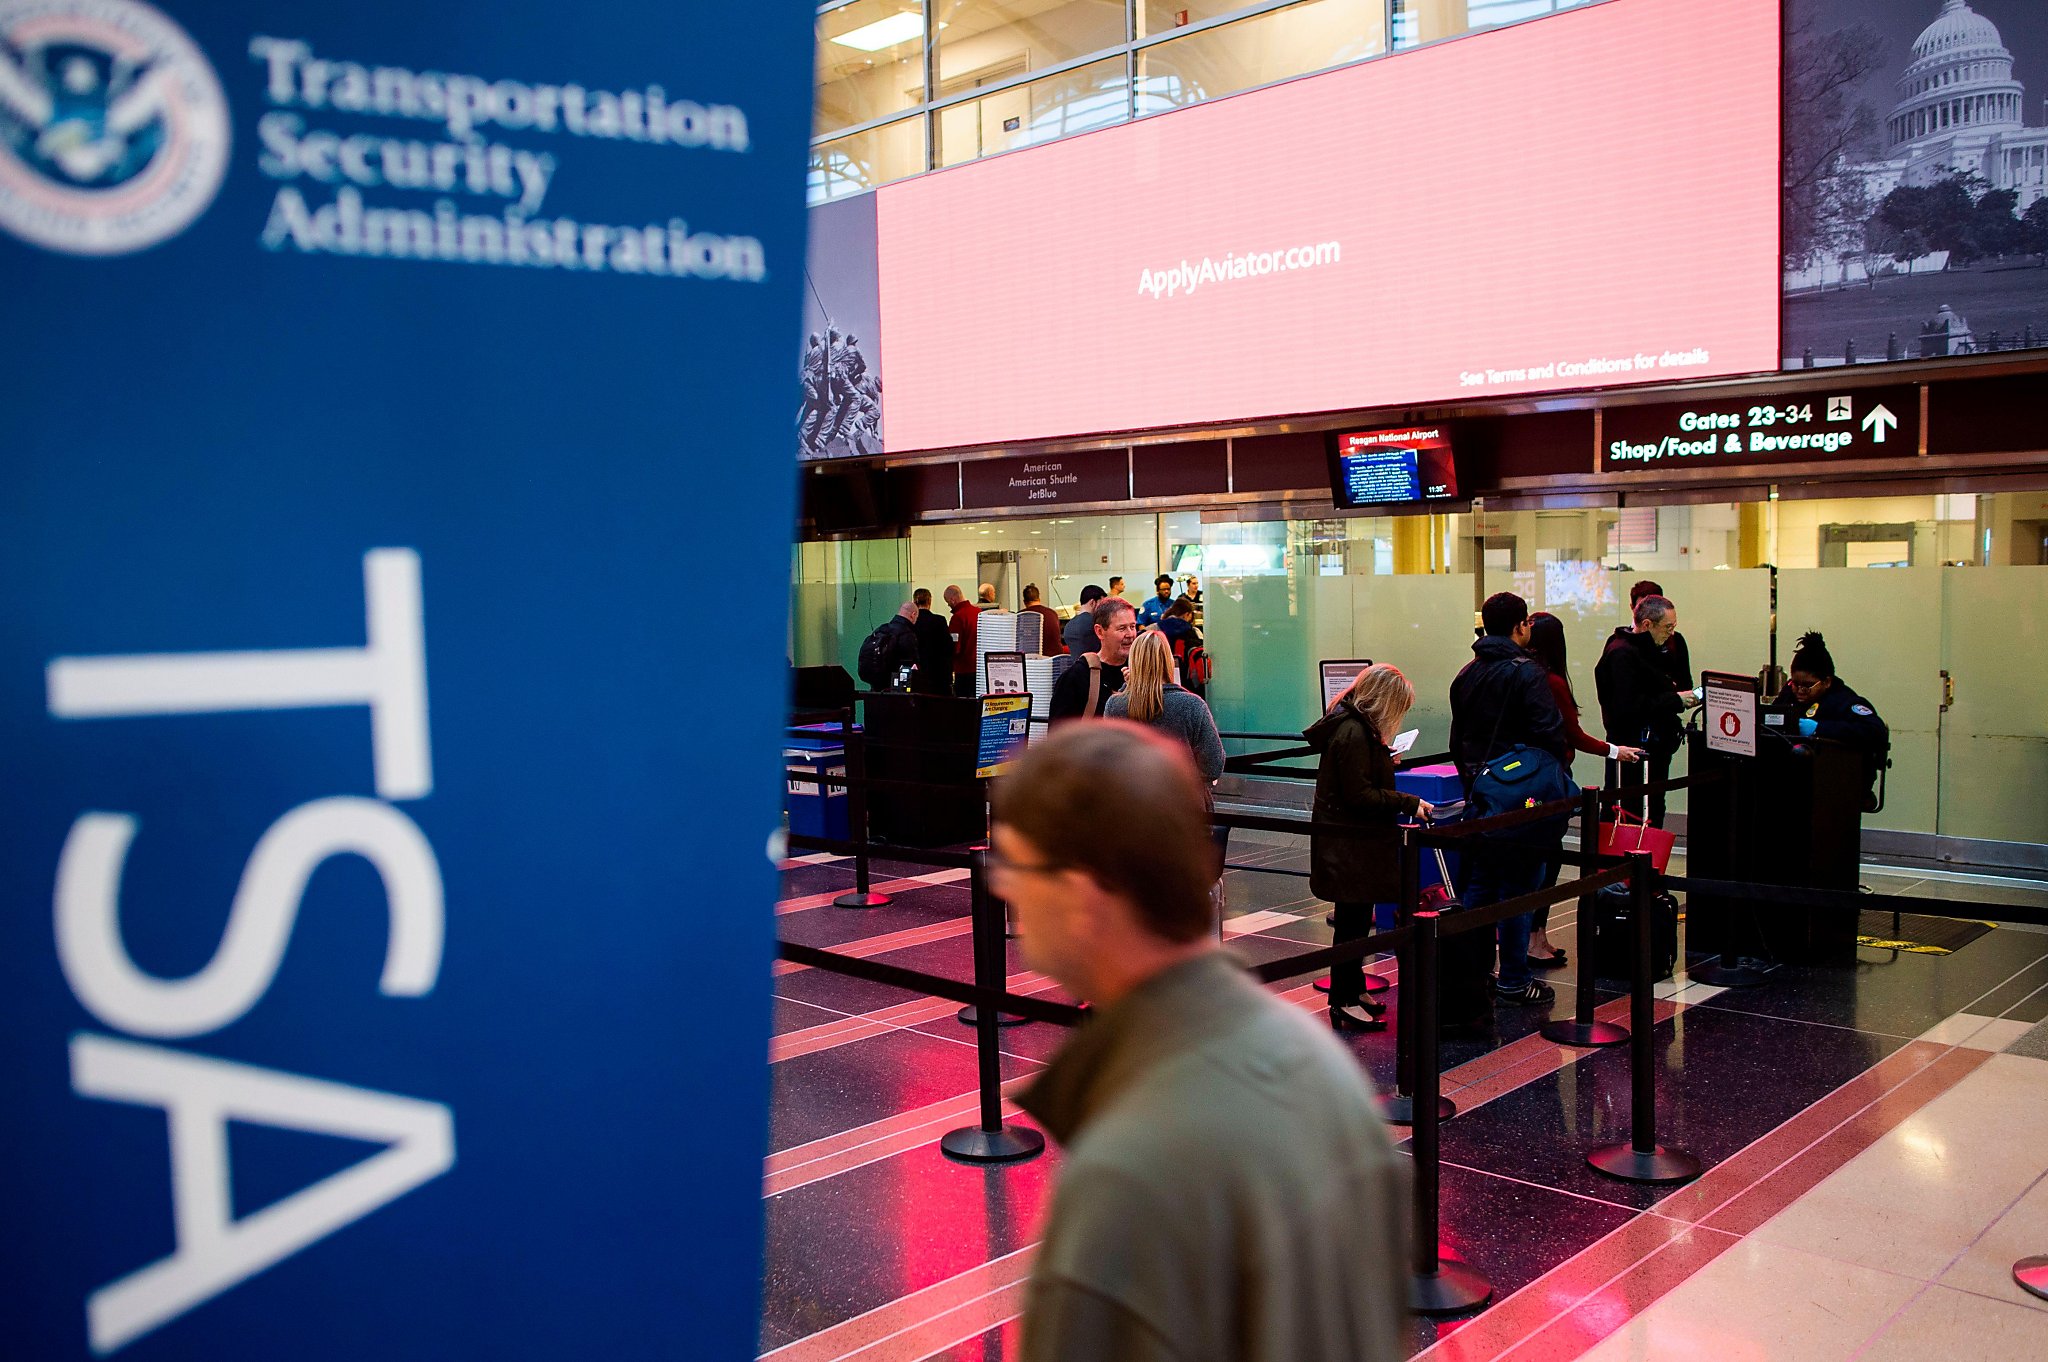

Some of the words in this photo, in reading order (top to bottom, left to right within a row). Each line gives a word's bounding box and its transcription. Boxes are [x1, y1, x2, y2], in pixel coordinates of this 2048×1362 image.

[249, 36, 749, 152] Transportation
[258, 111, 556, 214] Security
[260, 186, 766, 282] Administration
[1138, 241, 1341, 299] ApplyAviator.com
[1460, 371, 1484, 386] See
[1486, 368, 1525, 384] Terms
[1528, 362, 1554, 379] and
[1556, 357, 1632, 377] Conditions
[1634, 353, 1657, 370] for
[1658, 347, 1709, 367] details
[1679, 411, 1740, 432] Gates
[1747, 404, 1813, 427] 23-34
[1349, 436, 1377, 445] Reagan
[1379, 432, 1410, 442] National
[1411, 429, 1439, 441] Airport
[1610, 434, 1717, 462] Shop/Food
[1724, 433, 1742, 453] &
[1750, 430, 1852, 452] Beverage
[1009, 476, 1047, 487] American
[1049, 473, 1078, 485] Shuttle
[1023, 462, 1062, 473] American
[1028, 488, 1057, 499] JetBlue
[46, 547, 456, 1357] TSA
